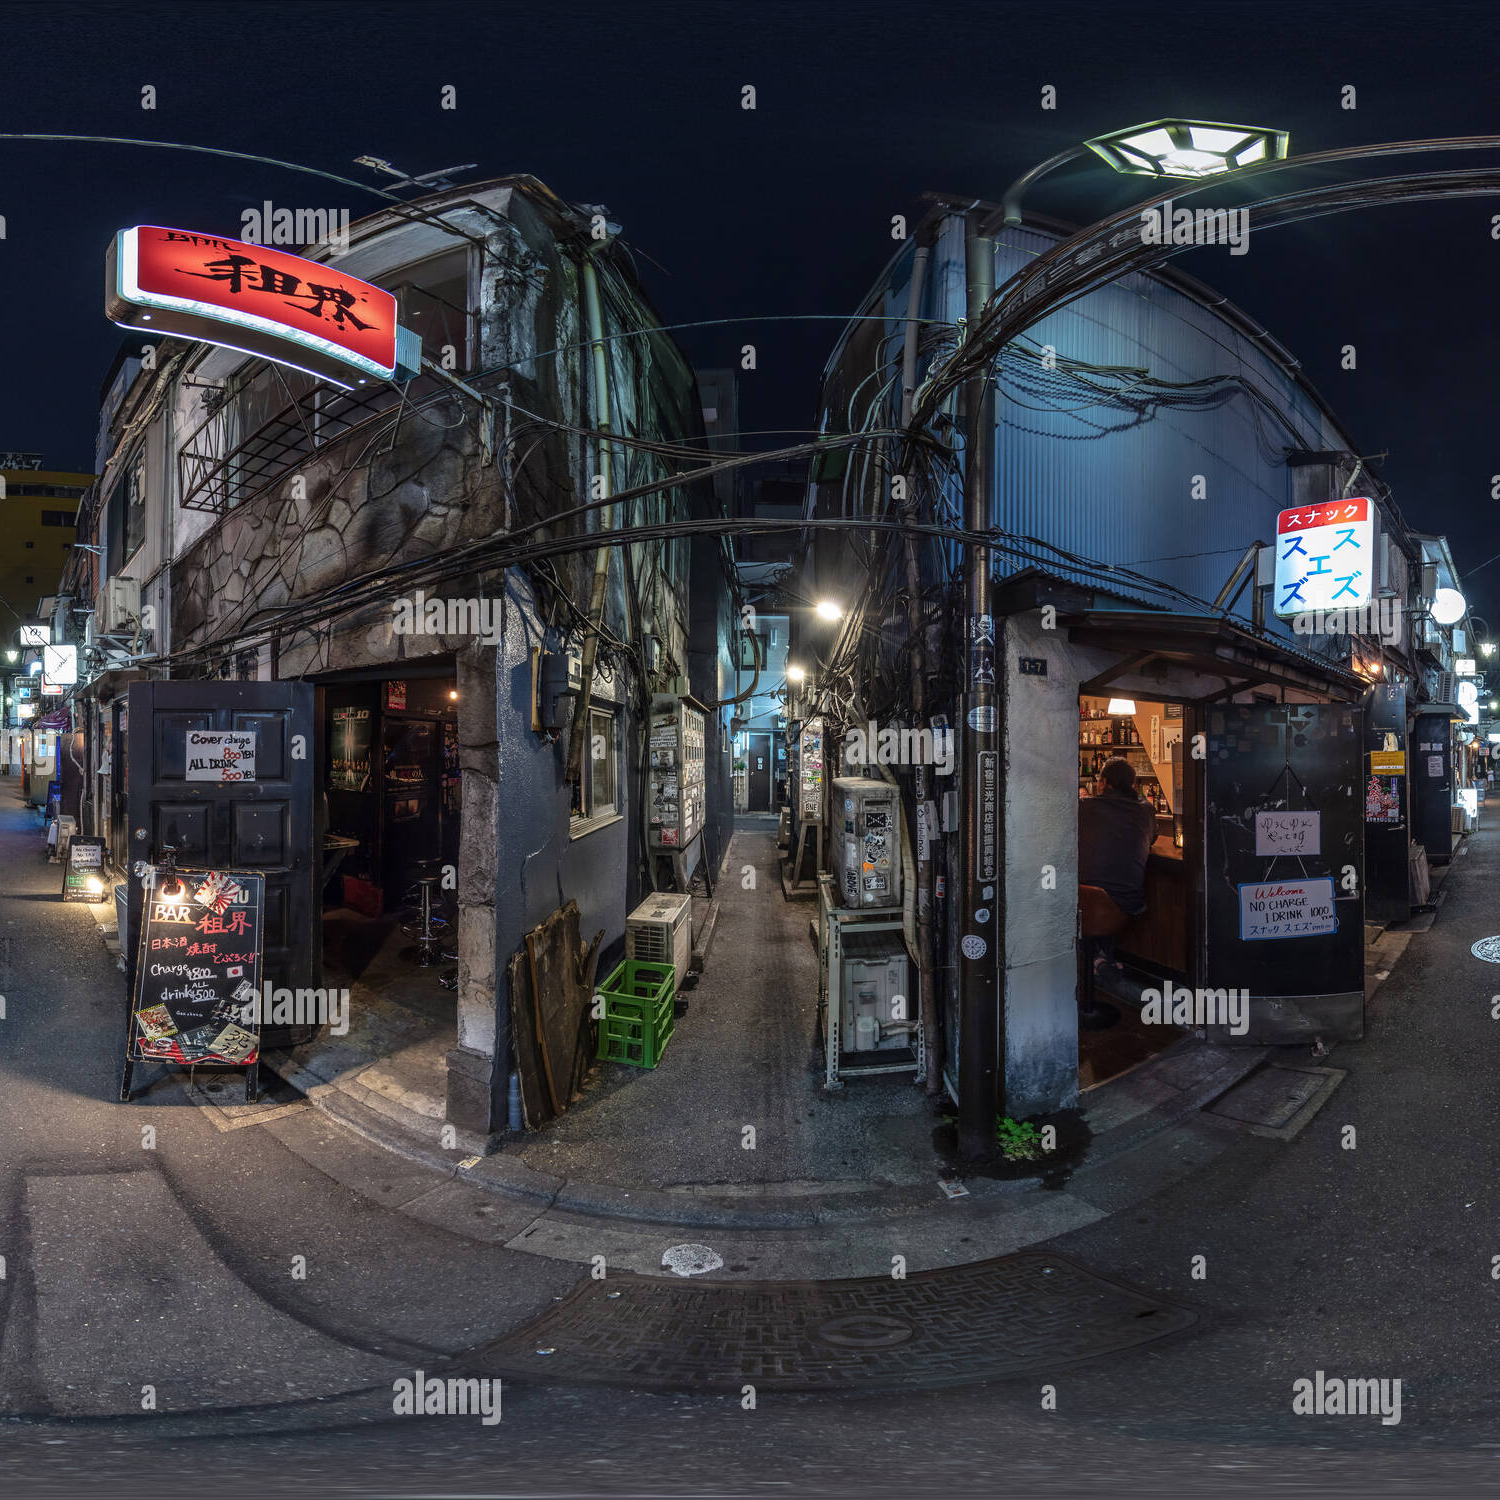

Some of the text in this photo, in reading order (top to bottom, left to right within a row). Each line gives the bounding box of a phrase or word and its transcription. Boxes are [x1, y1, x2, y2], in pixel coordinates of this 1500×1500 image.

[159, 231, 241, 252] BAR
[174, 254, 380, 331] 租界
[1287, 505, 1358, 527] スナック
[1024, 661, 1041, 673] 1-7
[190, 733, 223, 745] Cover
[223, 747, 254, 760] 800 YEN
[189, 758, 239, 771] ALL DRINK
[221, 768, 242, 781] 500
[1255, 886, 1306, 900] Welcome
[1249, 897, 1309, 913] NO CHARGE
[155, 904, 194, 923] BAR
[1272, 909, 1303, 923] DRINK
[1310, 905, 1330, 918] 1000
[195, 911, 253, 936] 租界
[1250, 925, 1280, 935] スナック
[1284, 921, 1313, 932] スエズ
[151, 936, 188, 951] 日本酒
[186, 943, 218, 957] 焼酎
[151, 963, 189, 977] Charge
[160, 984, 192, 1000] drink
[191, 981, 209, 989] ALL
